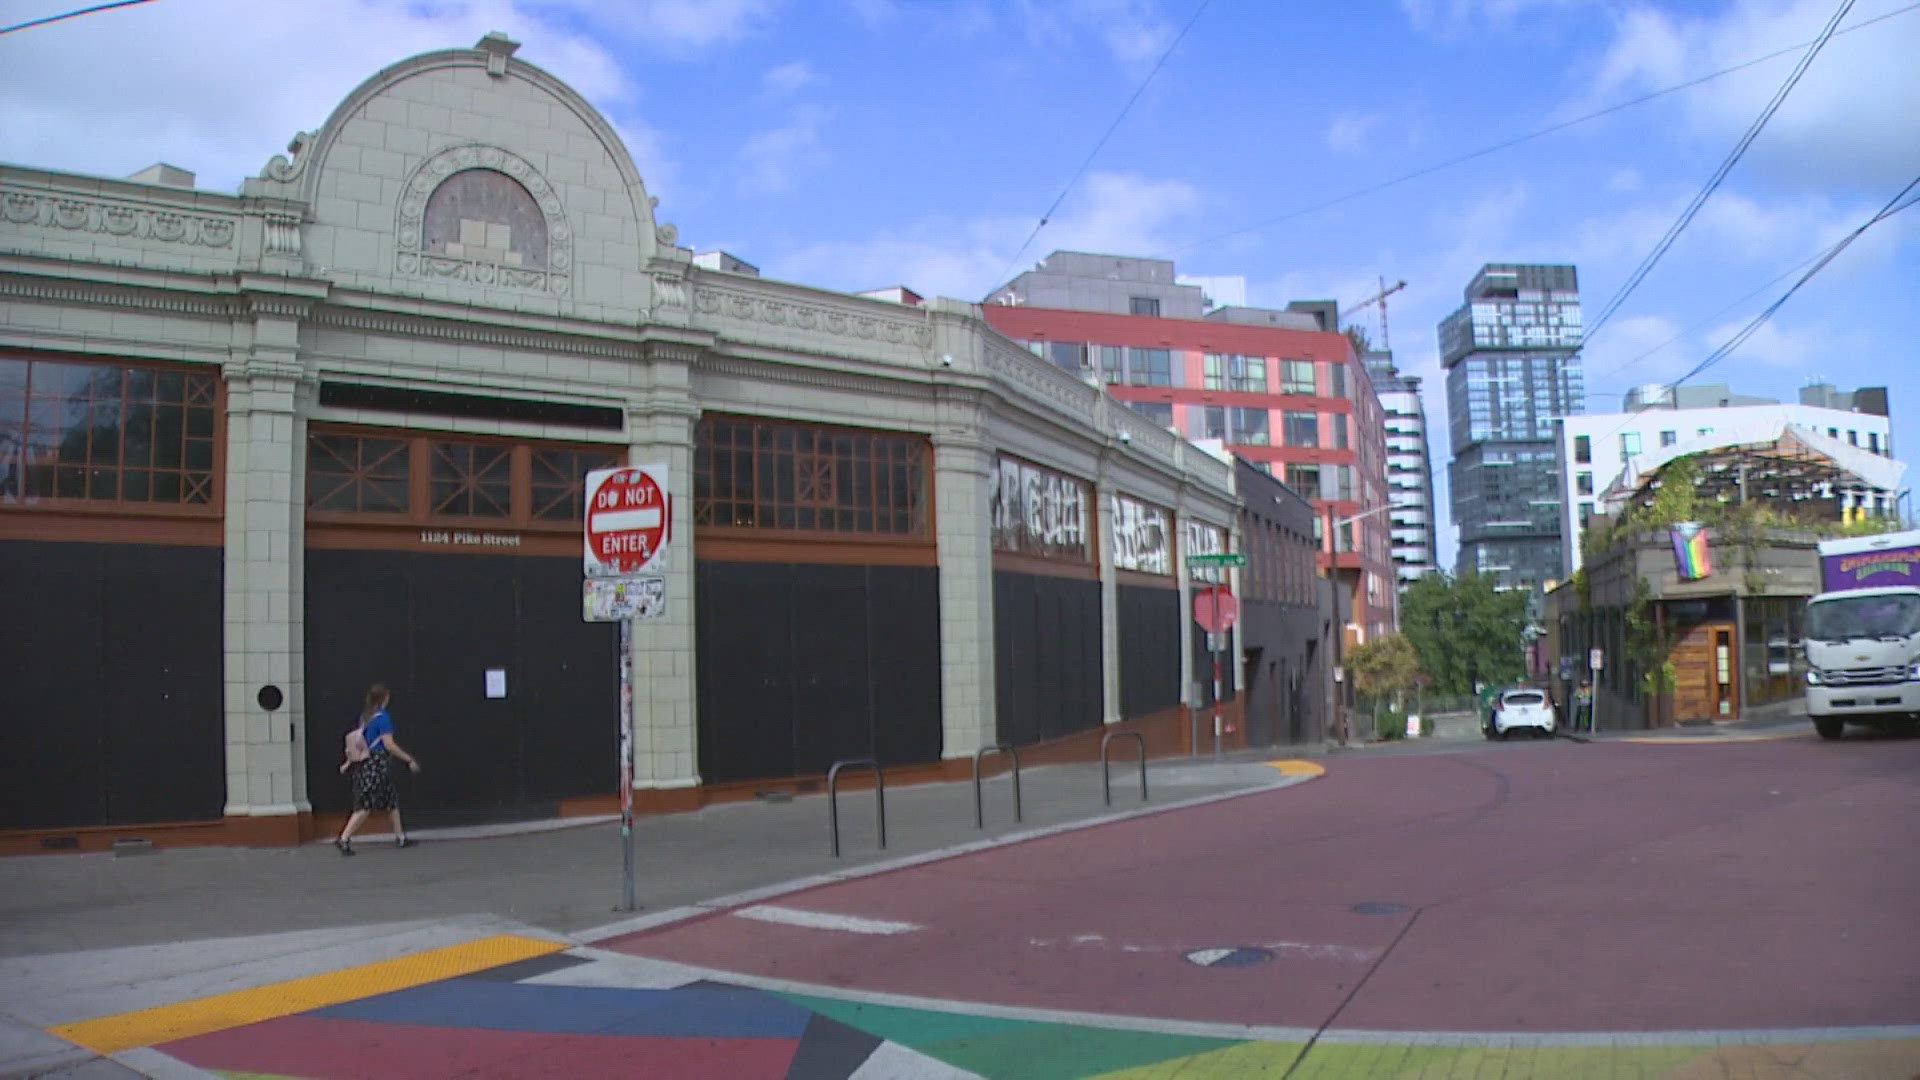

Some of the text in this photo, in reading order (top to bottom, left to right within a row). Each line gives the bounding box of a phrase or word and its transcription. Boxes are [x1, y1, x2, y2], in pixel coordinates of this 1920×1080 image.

[625, 487, 655, 506] NOT
[454, 532, 481, 545] Pike
[482, 533, 520, 546] Street
[602, 534, 648, 554] ENTER
